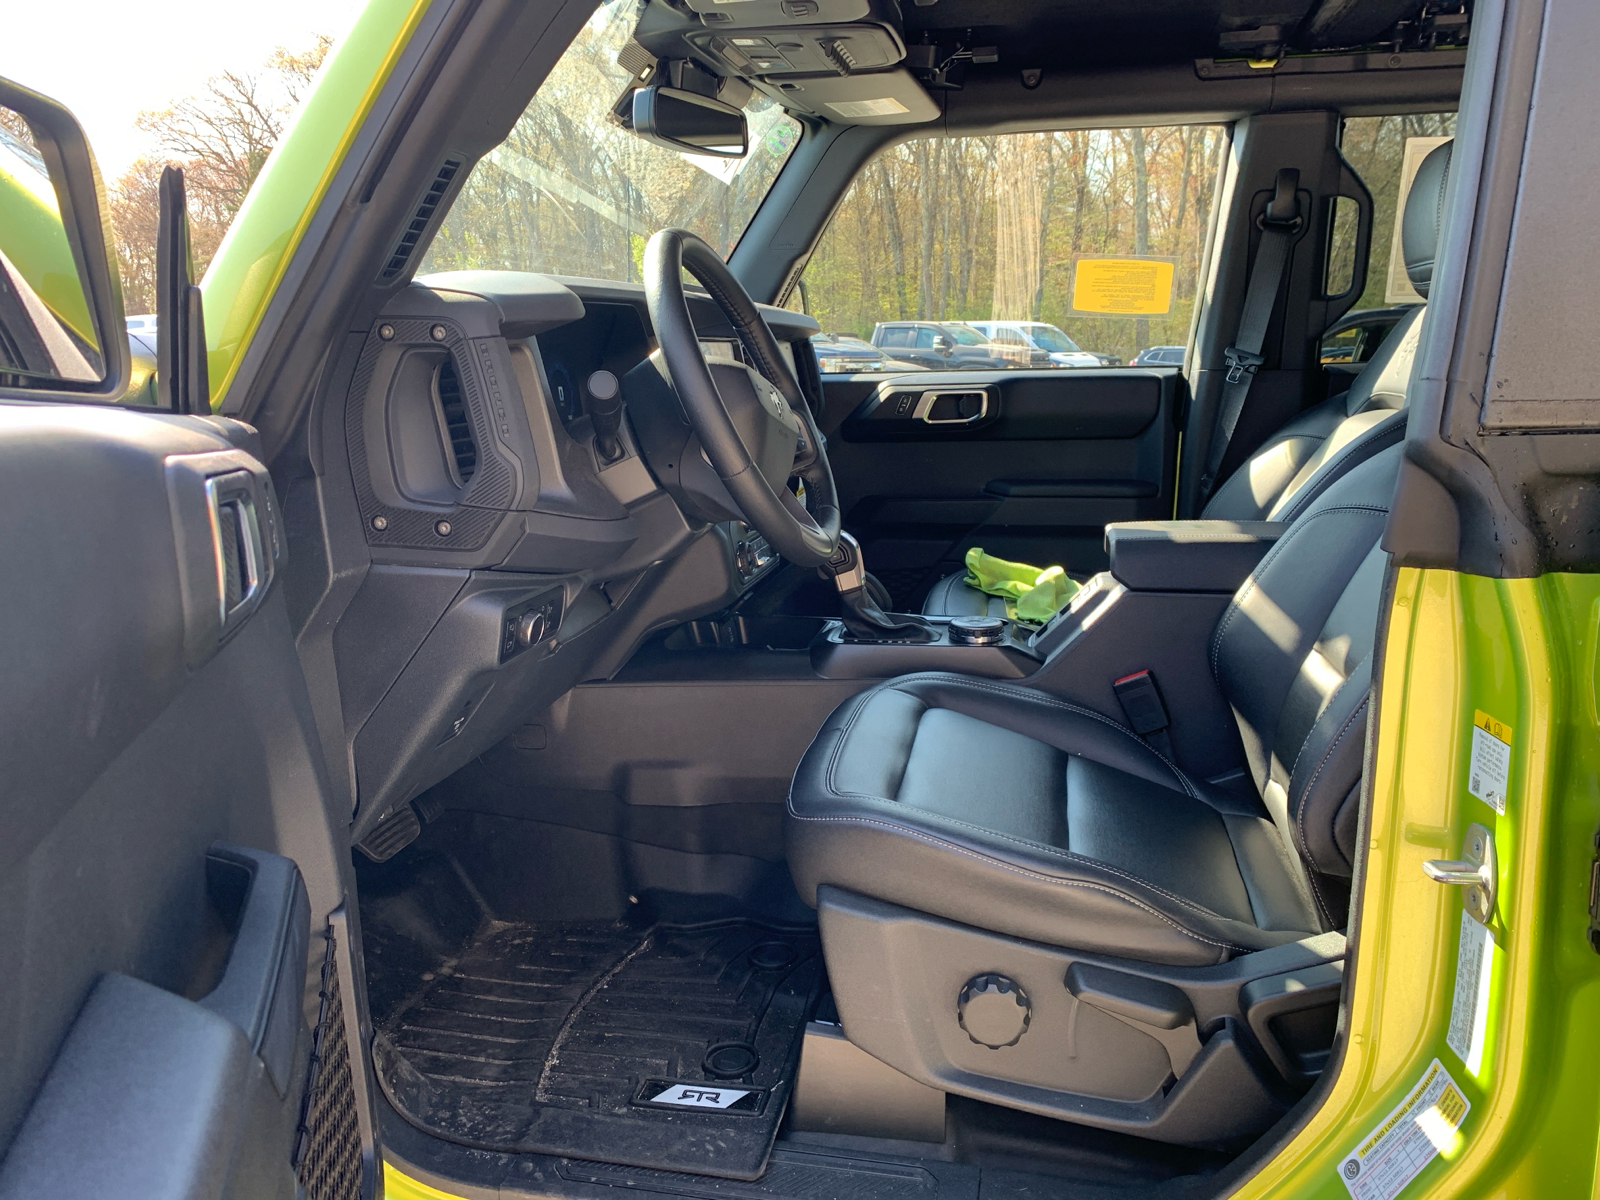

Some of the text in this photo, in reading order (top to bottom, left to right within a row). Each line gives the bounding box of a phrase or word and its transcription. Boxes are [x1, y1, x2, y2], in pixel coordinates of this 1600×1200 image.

[480, 343, 510, 438] BRONCO
[1361, 1141, 1373, 1155] TIRE
[1372, 1129, 1385, 1144] AND
[1384, 1106, 1408, 1132] LOADING
[1408, 1068, 1438, 1108] INFORMATION
